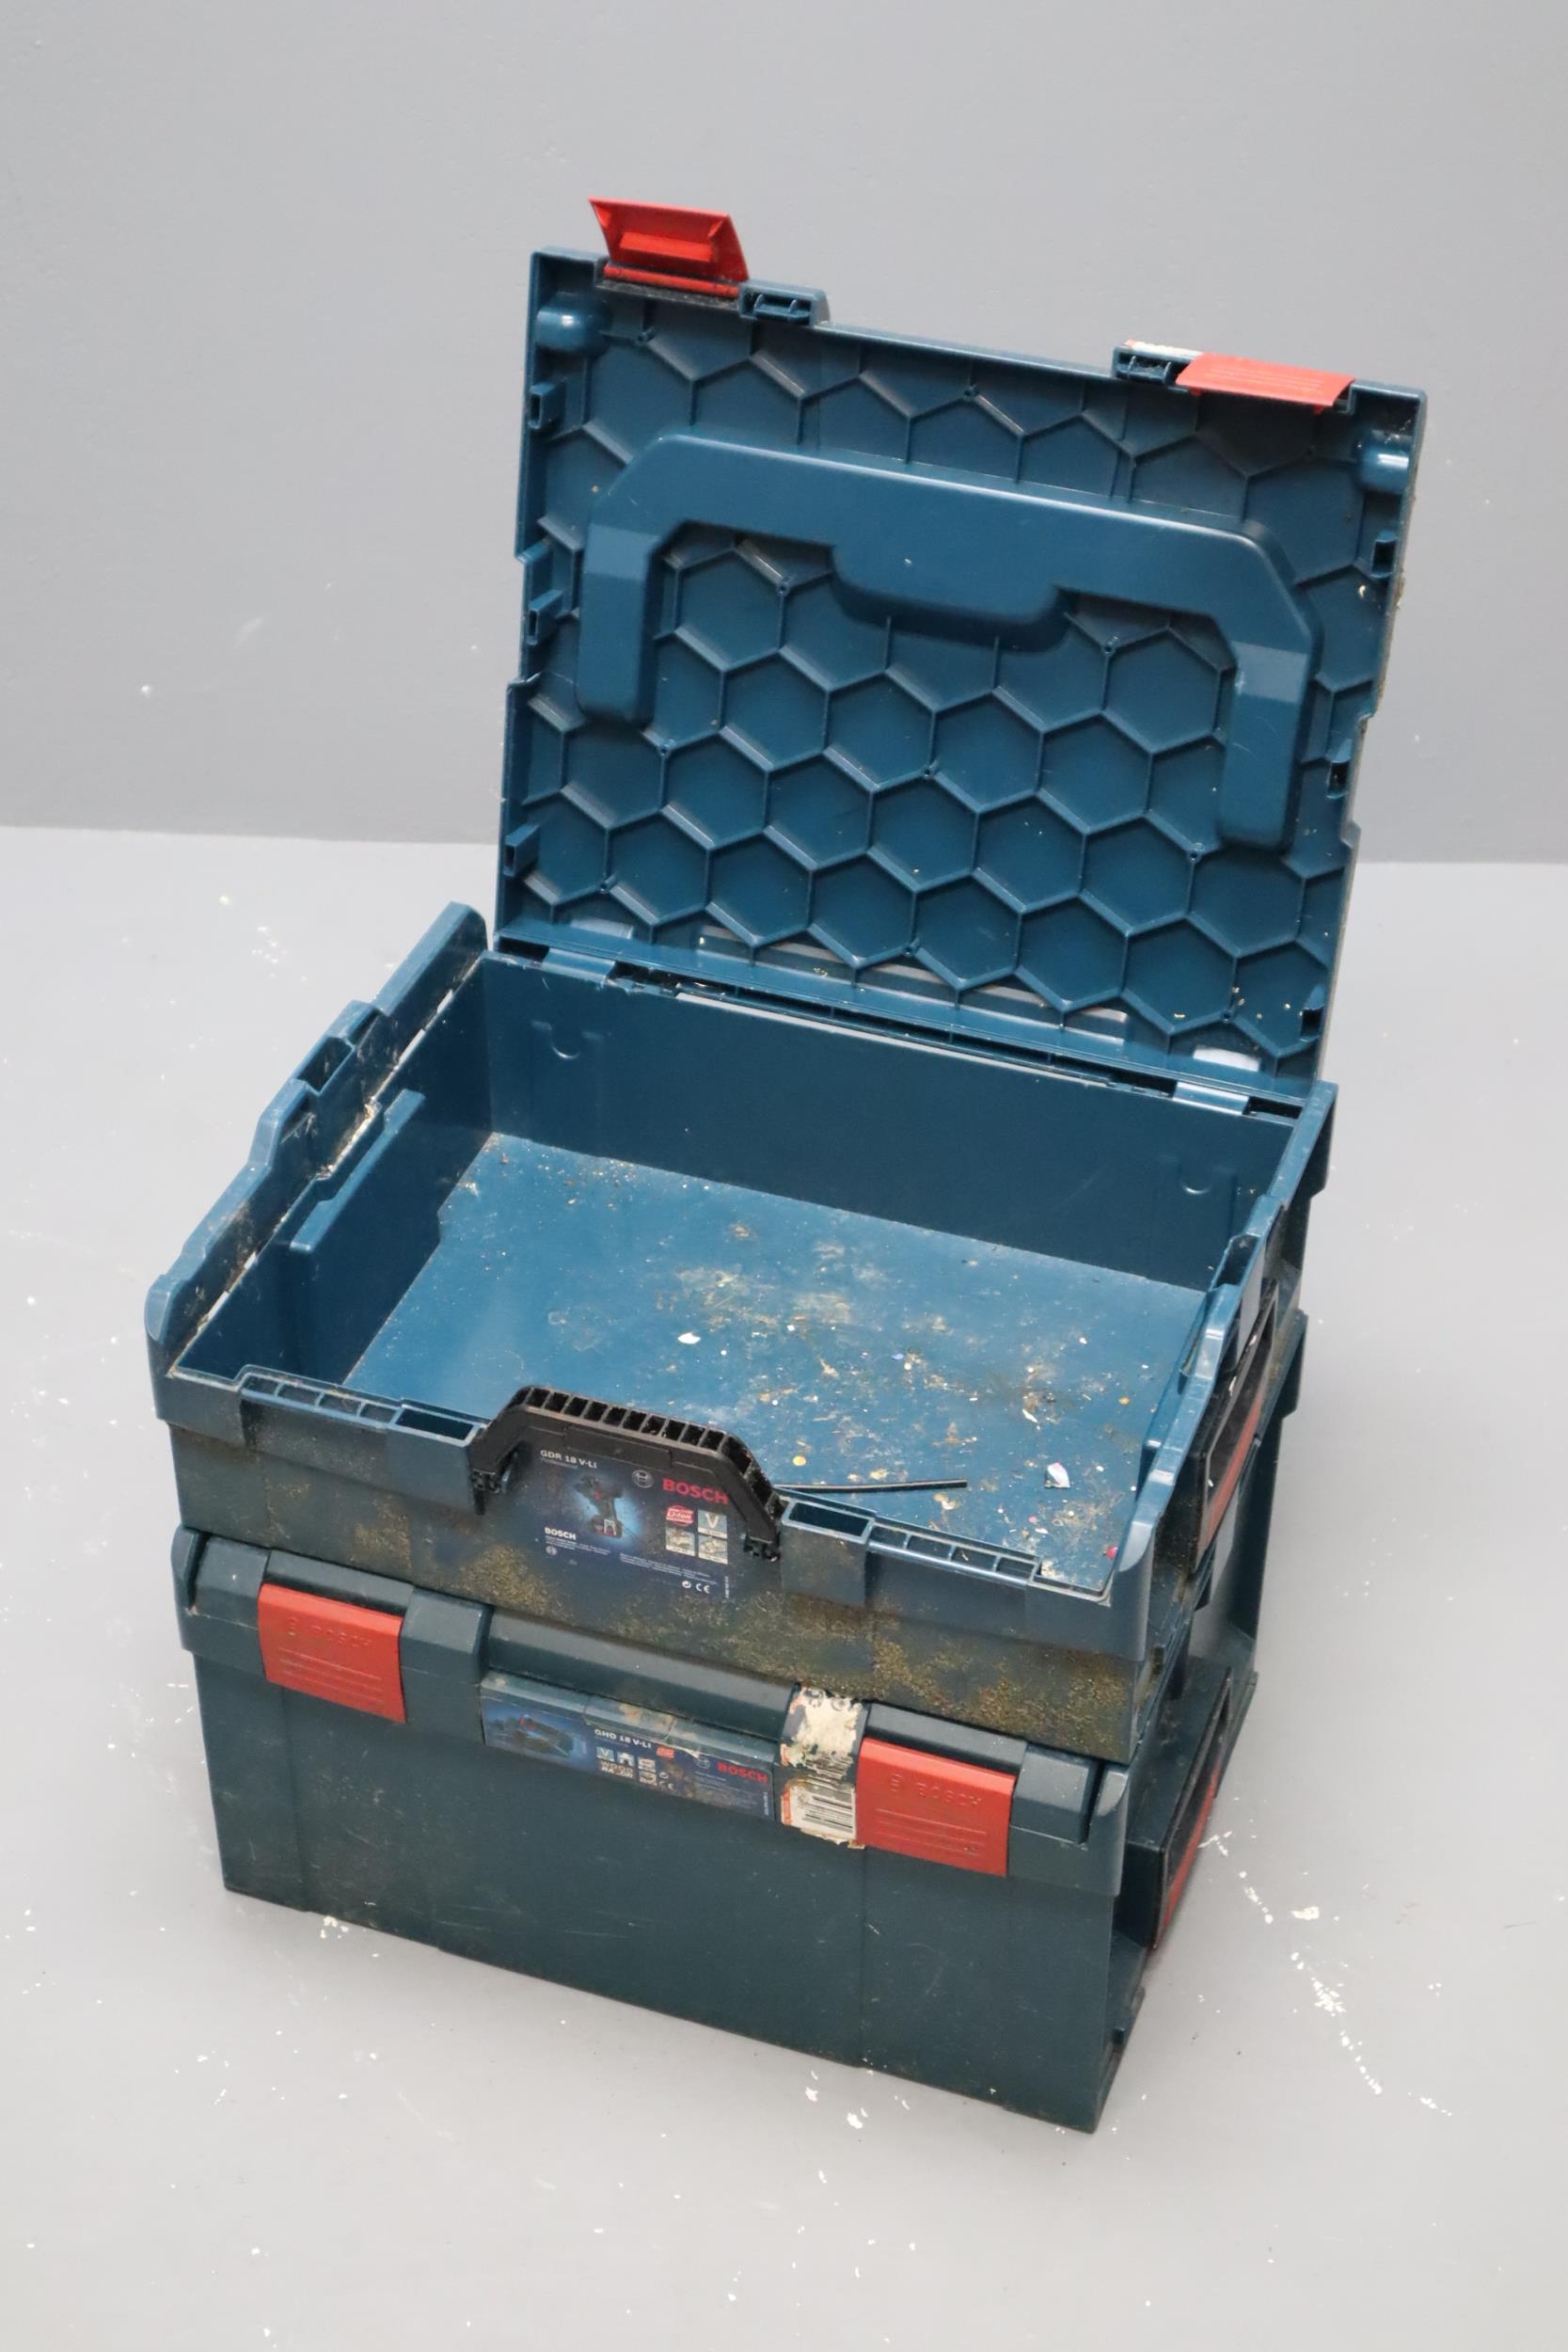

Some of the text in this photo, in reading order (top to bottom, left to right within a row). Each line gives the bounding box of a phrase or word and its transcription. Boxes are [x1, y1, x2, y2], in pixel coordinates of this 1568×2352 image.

[540, 1450, 562, 1460] GDR
[565, 1455, 577, 1464] 18
[662, 1476, 729, 1504] BOSCH
[544, 1527, 577, 1540] BOSCH
[619, 1736, 631, 1744] 18
[717, 1761, 768, 1784] BOSCH
